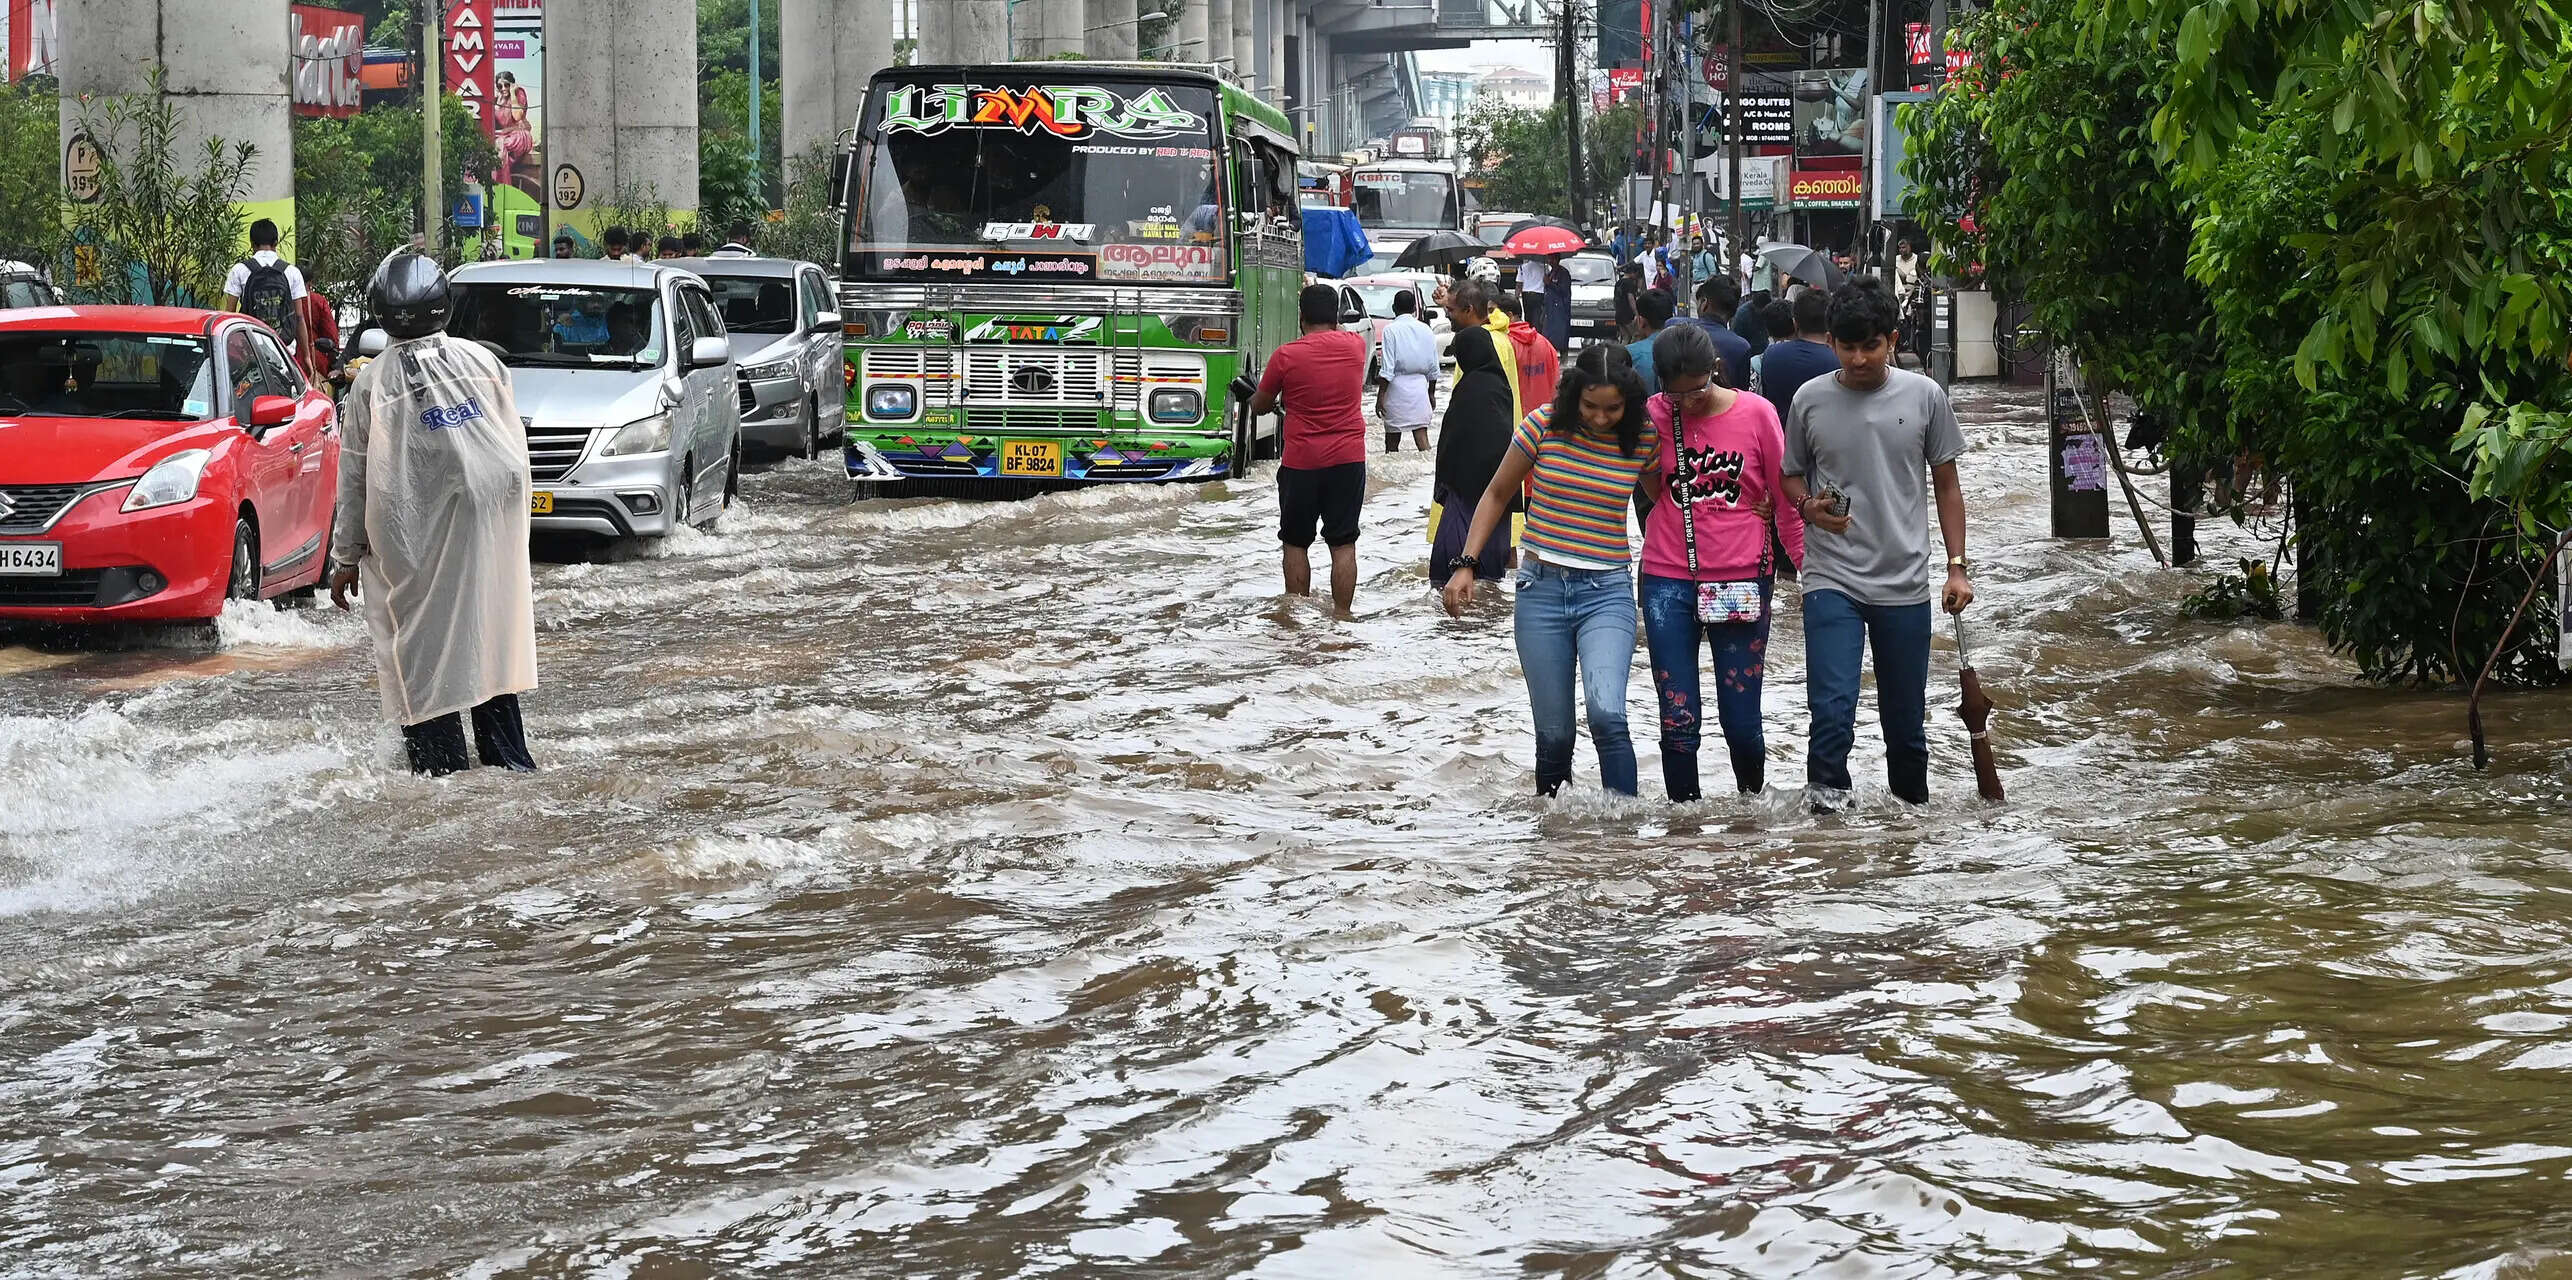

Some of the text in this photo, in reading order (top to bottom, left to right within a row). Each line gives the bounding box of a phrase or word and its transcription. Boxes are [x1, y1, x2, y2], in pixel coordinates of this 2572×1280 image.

[1723, 98, 1791, 107] AIGO SUITES
[878, 84, 1208, 140] LIMRA
[1752, 122, 1791, 131] ROOMS
[1071, 145, 1138, 156] PRODUCED
[1138, 146, 1156, 156] BY
[563, 172, 569, 183] P
[1742, 178, 1763, 186] rveda
[1743, 171, 1768, 179] Kerala
[558, 190, 577, 201] 392
[982, 222, 1097, 242] GOWRI
[1008, 325, 1060, 341] TATA
[420, 397, 483, 431] Real
[1015, 444, 1048, 457] KL 07
[1676, 441, 1687, 475] FOREVER
[1677, 444, 1745, 484] Stay
[1681, 482, 1689, 505] YOUNG
[1683, 505, 1694, 543] FOREVER
[13, 550, 55, 568] 6434
